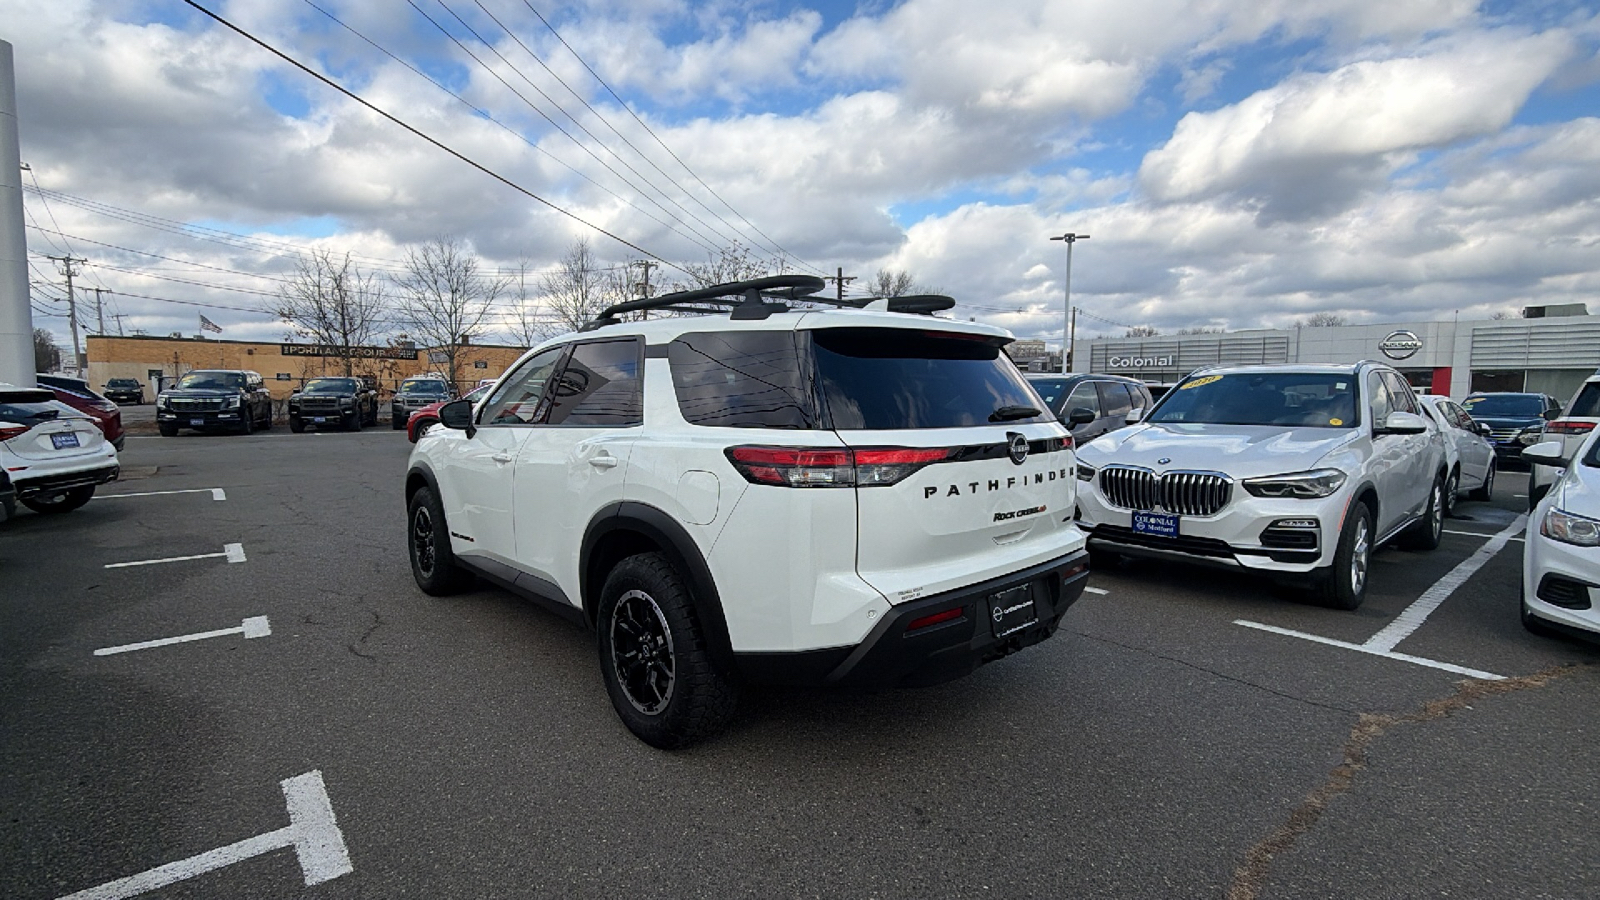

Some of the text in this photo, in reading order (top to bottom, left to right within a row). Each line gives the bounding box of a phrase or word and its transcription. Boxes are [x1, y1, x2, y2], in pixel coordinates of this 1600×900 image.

[1110, 355, 1172, 367] Colonial
[993, 511, 1016, 522] ROCK
[1134, 515, 1176, 527] COLNIAL
[1148, 524, 1174, 533] Medford
